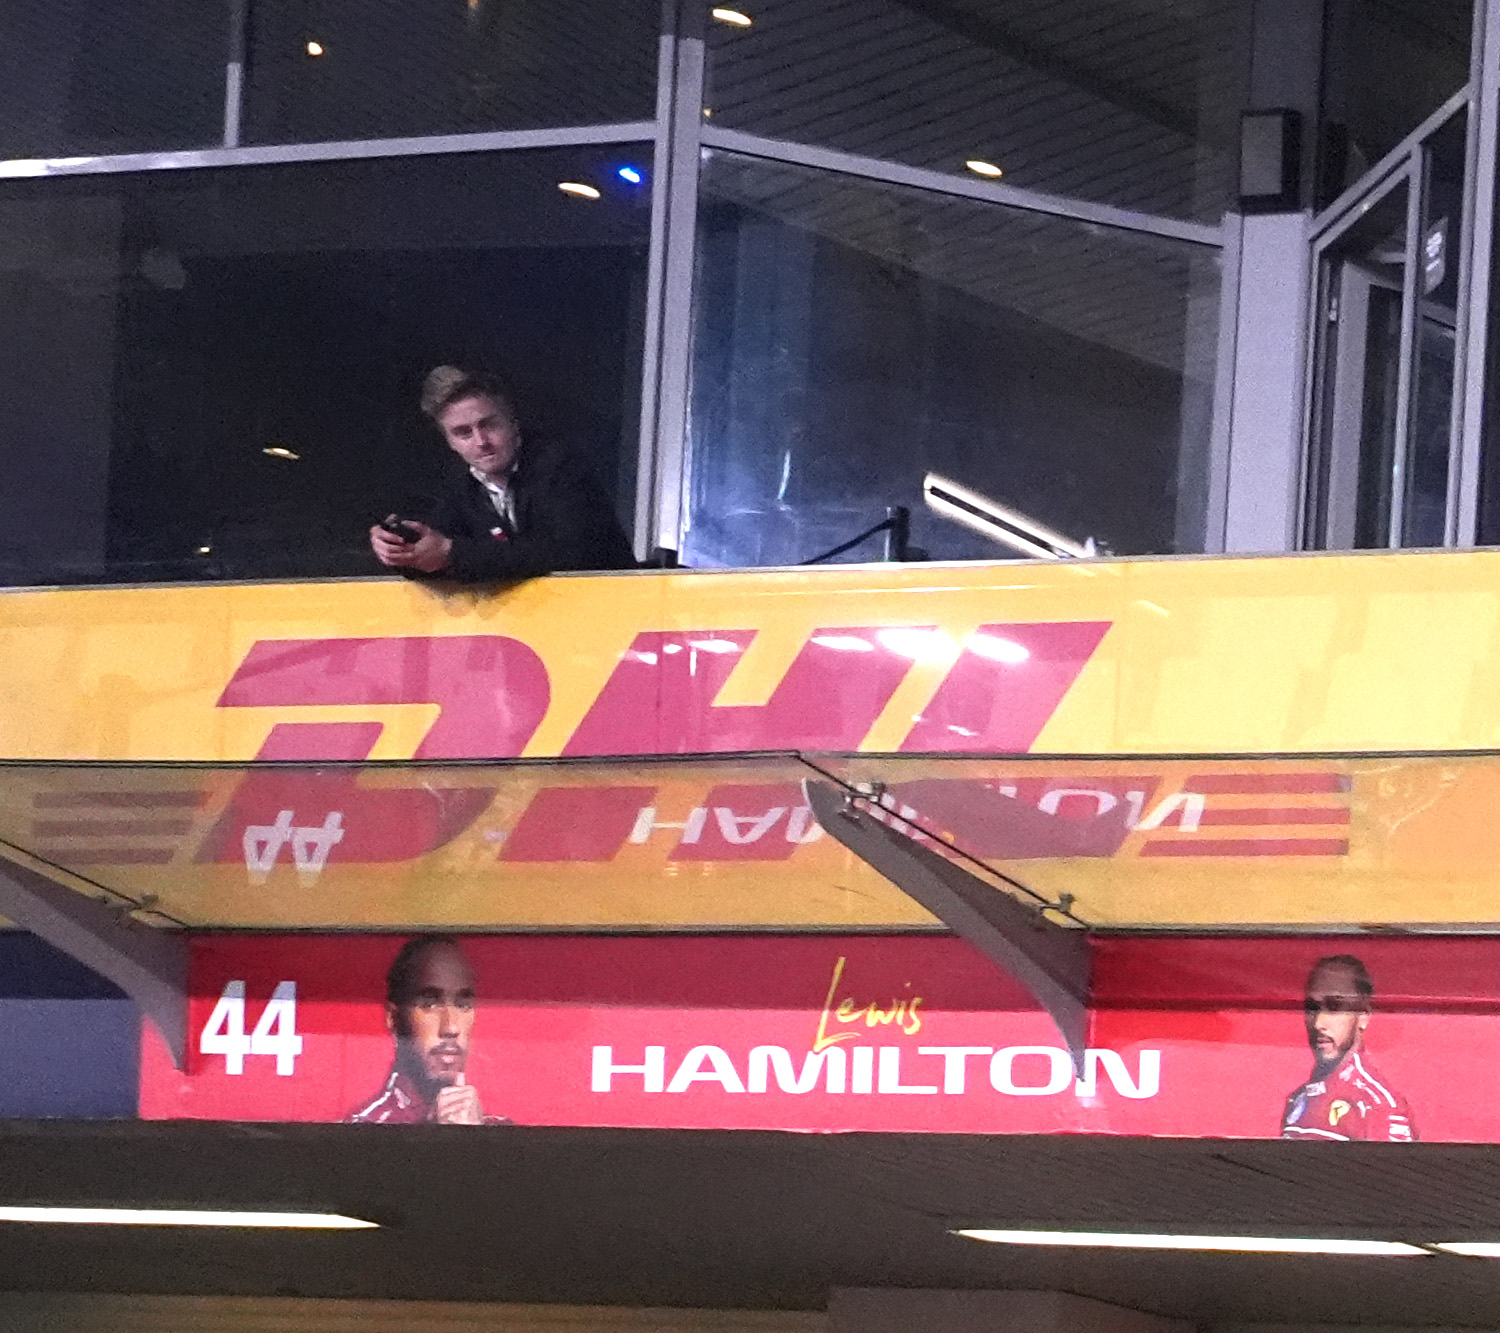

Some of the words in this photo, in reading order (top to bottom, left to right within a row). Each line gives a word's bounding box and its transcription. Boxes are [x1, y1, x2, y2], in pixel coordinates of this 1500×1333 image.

[206, 618, 1116, 866] DHL
[200, 980, 303, 1077] 44
[813, 957, 924, 1053] Lewis
[590, 1042, 1161, 1100] HAMILTON
